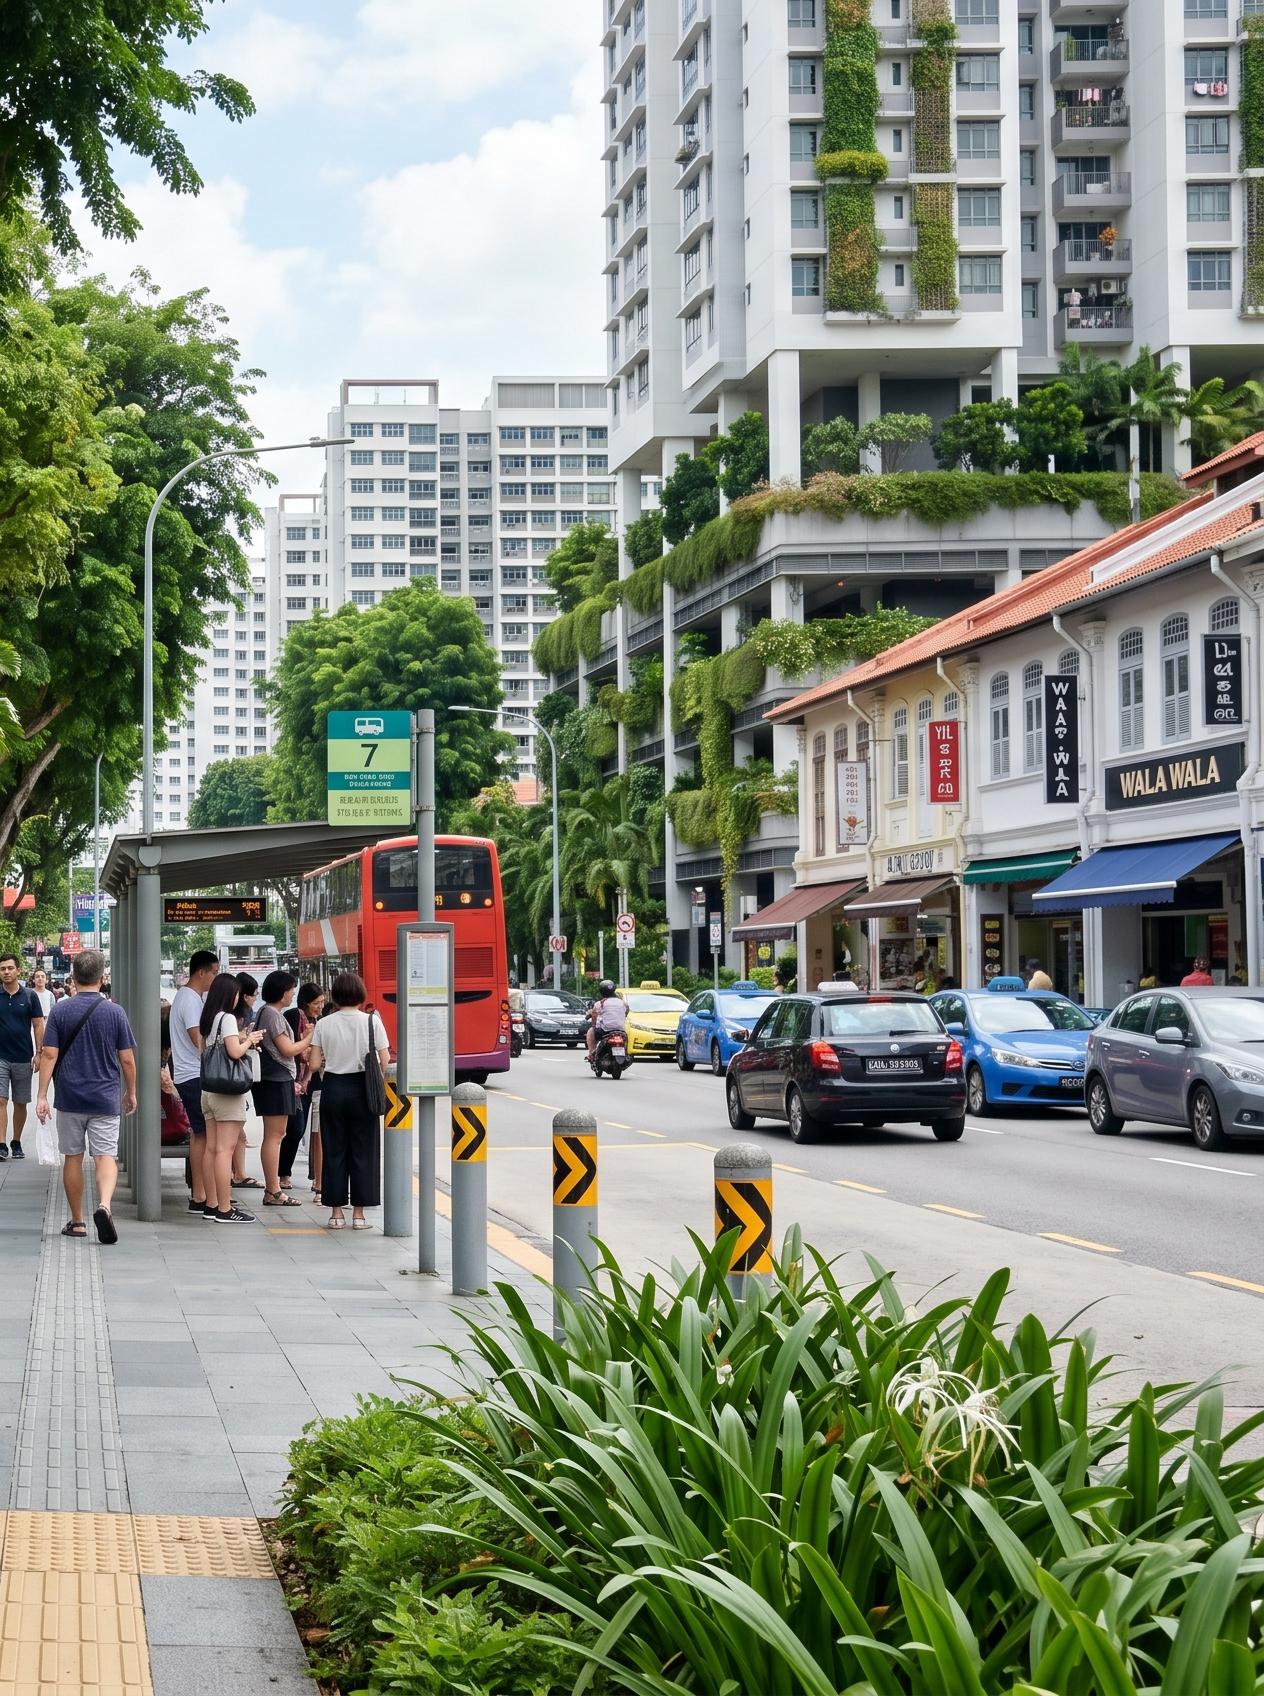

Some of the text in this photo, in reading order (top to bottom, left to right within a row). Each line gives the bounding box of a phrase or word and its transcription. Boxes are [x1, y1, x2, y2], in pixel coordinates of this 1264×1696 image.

[360, 743, 379, 768] 7
[1120, 755, 1221, 799] WALA WALA
